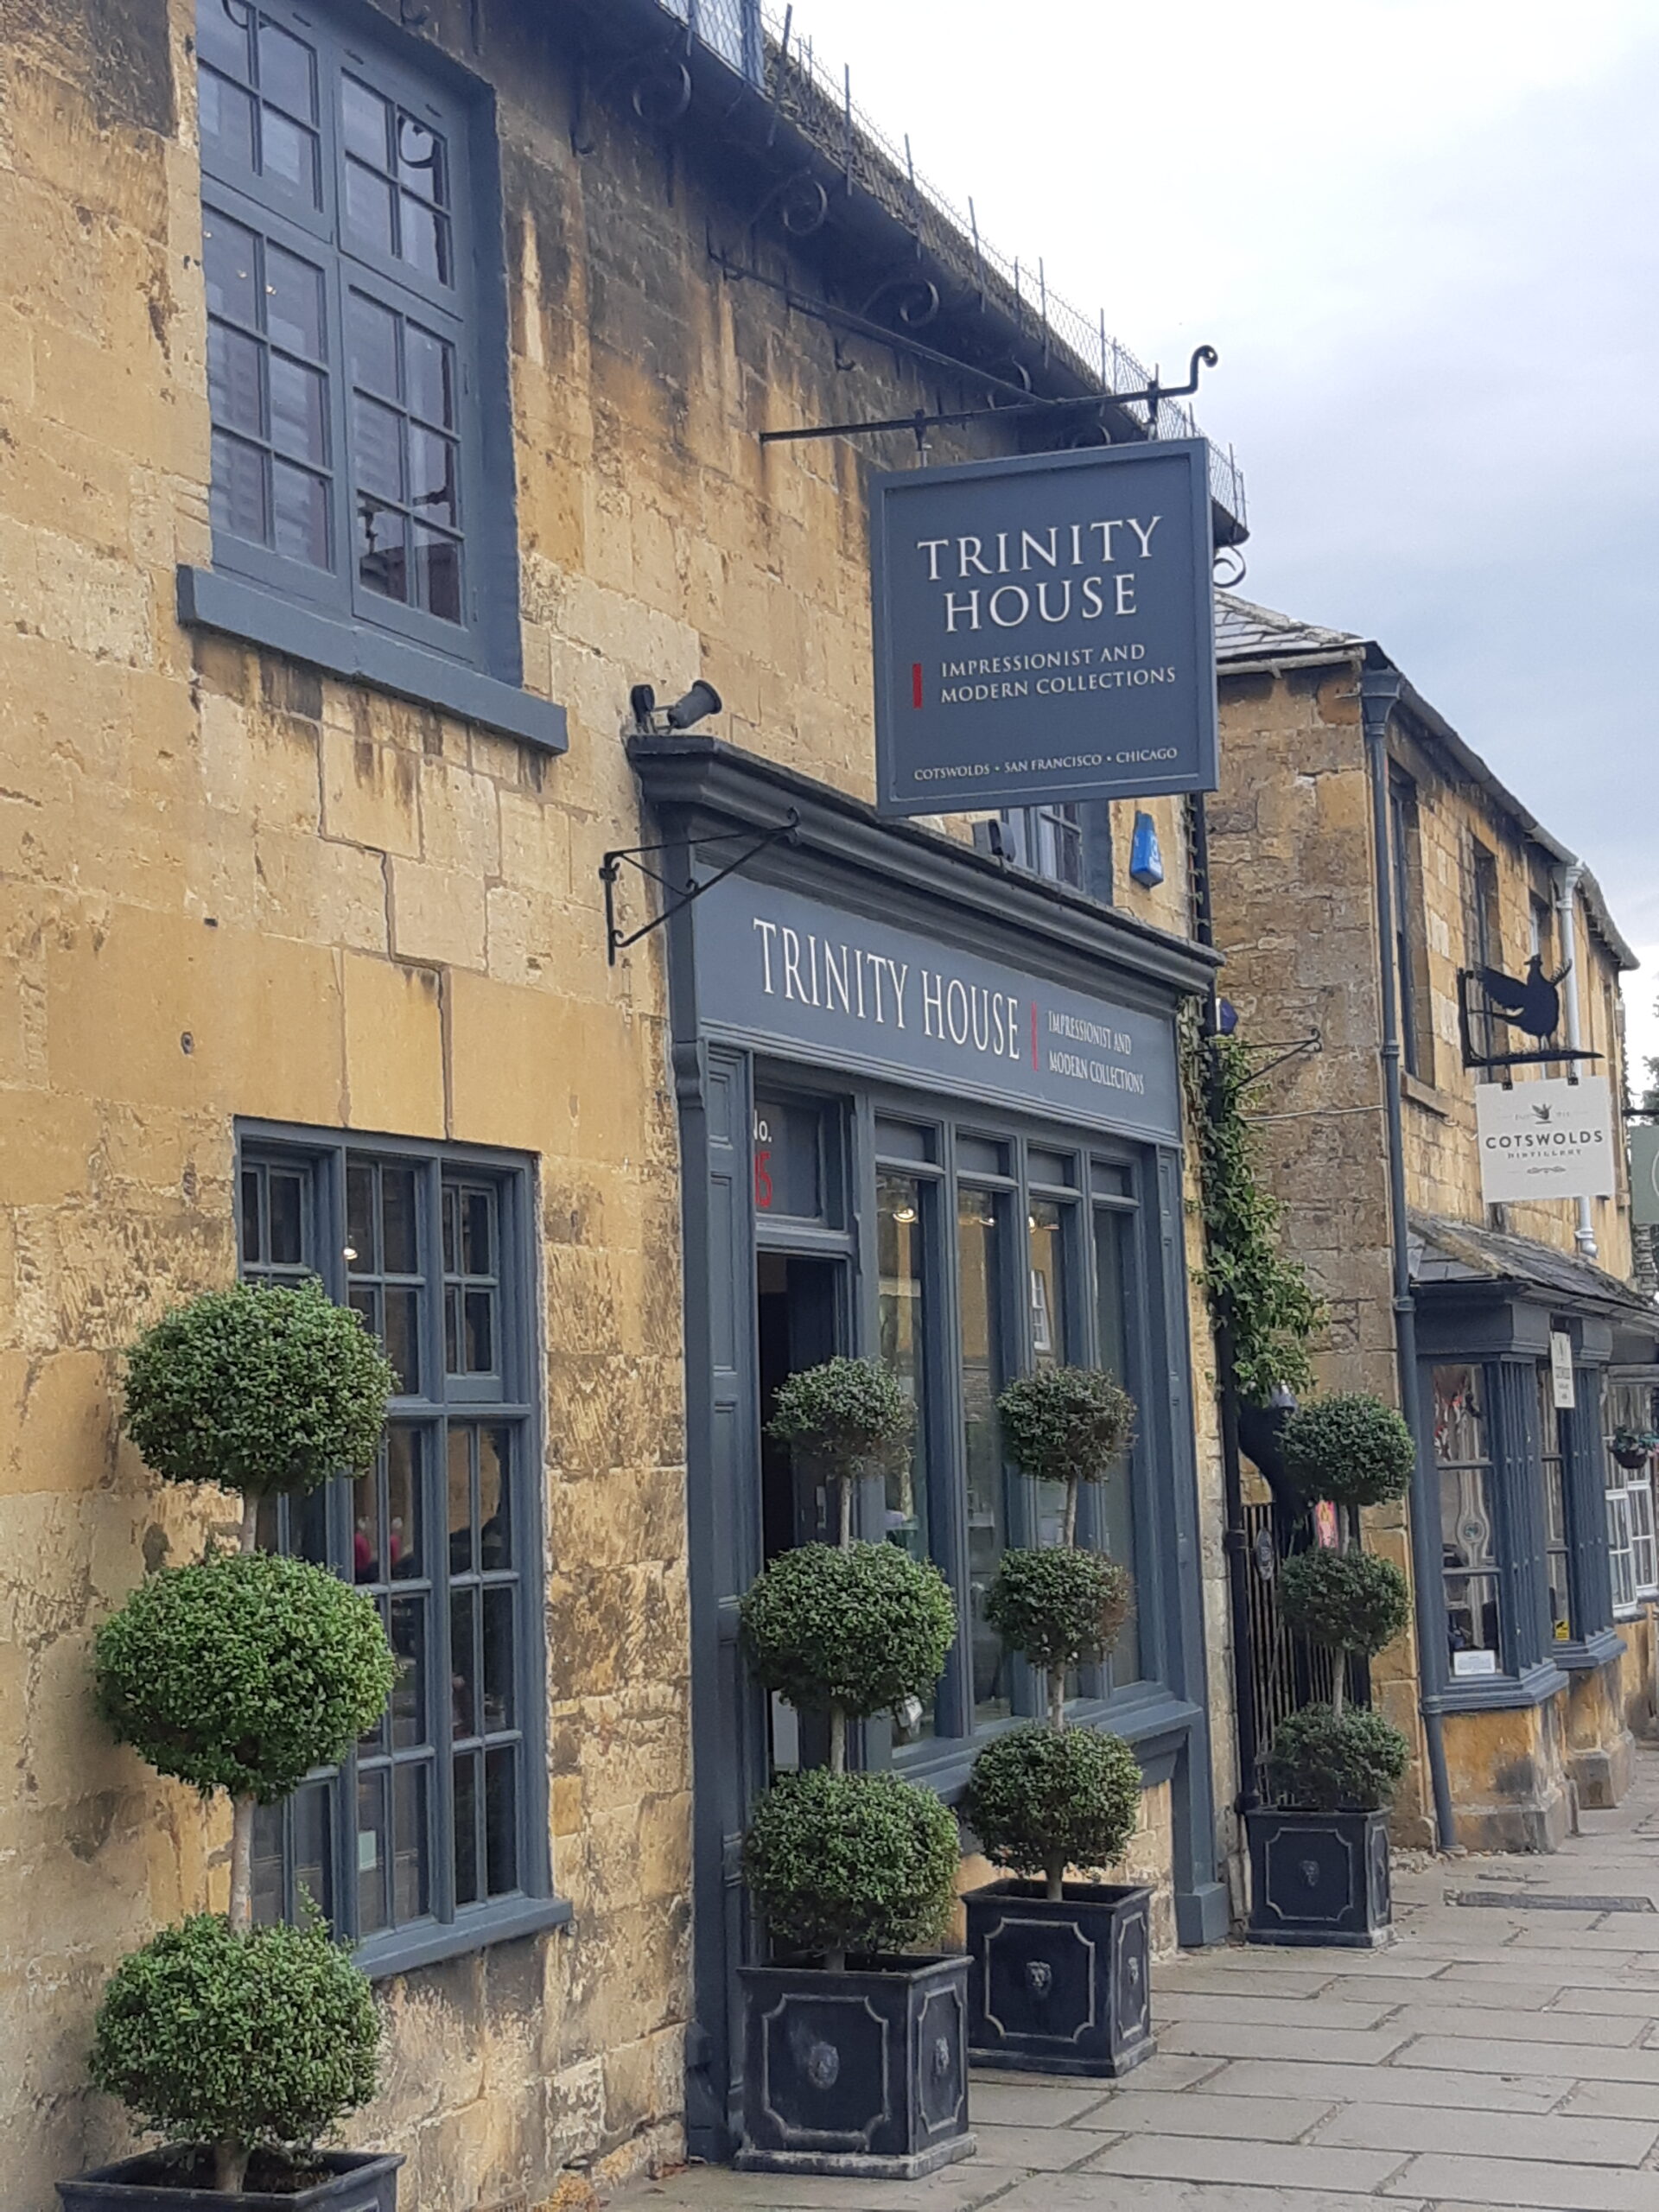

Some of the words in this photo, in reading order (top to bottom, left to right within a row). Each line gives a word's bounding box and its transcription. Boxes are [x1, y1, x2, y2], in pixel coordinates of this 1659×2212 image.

[917, 516, 1163, 581] TRINITY
[944, 574, 1138, 632] HOUSE
[941, 649, 1094, 677] IMPRESSIONIST
[1100, 644, 1146, 662] AND
[941, 681, 1028, 703] MODERN
[1036, 667, 1176, 695] COLLECTIONS
[914, 765, 990, 781] COTSWOLDS
[1004, 760, 1028, 772] SAN
[1031, 753, 1103, 770] FRANCISCO
[1116, 747, 1178, 763] CHICAGO
[753, 917, 908, 1029] TRINITY
[922, 969, 1020, 1060] HOUSE
[1048, 1010, 1111, 1050] IMPRESSIONIST
[1114, 1032, 1132, 1055] AND
[1049, 1050, 1088, 1079] MODERN
[1090, 1060, 1144, 1095] COLLECTIONS
[1485, 1130, 1604, 1149] COTSWOLDS
